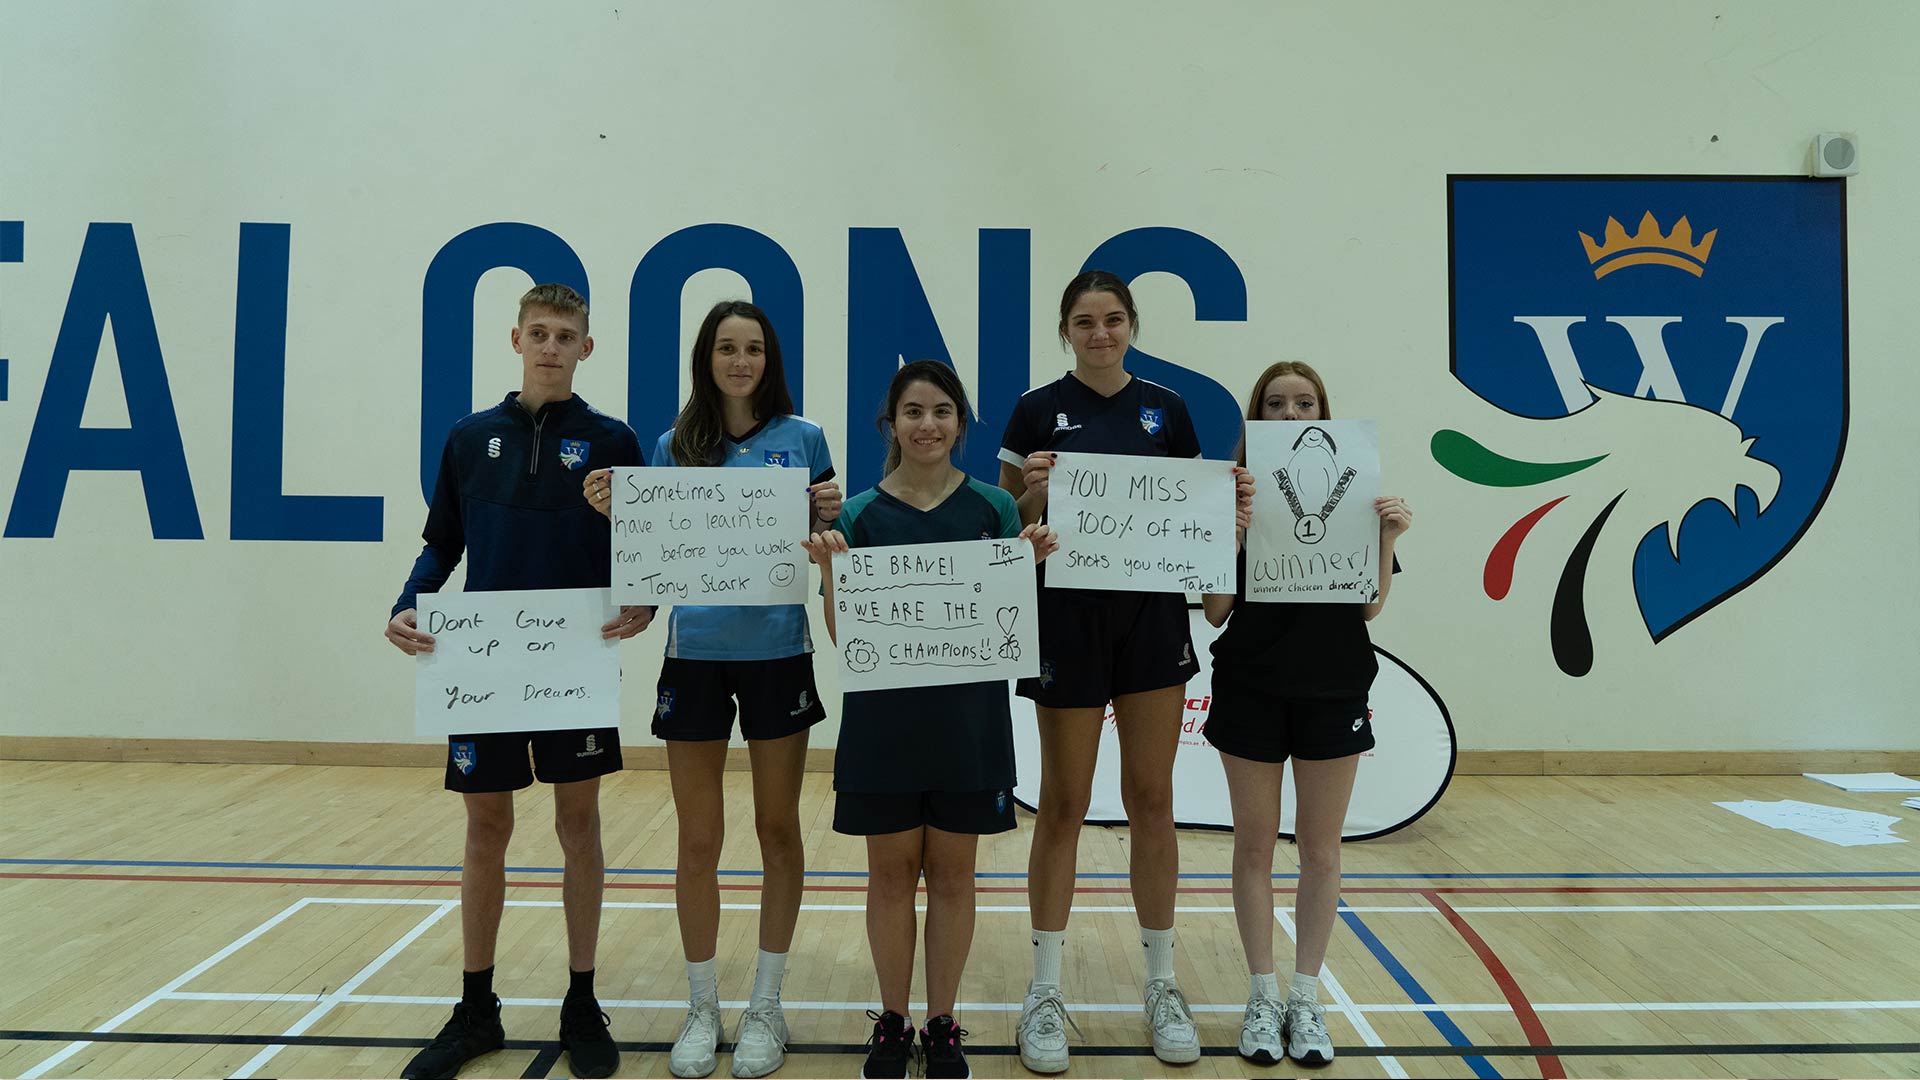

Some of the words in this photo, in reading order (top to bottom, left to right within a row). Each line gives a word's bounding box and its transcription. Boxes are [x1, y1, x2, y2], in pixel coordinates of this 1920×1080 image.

[0, 222, 1247, 541] ALCONS
[625, 474, 725, 504] Sometimes
[738, 485, 776, 512] you
[1067, 469, 1107, 497] YOU
[1129, 475, 1188, 502] MISS
[614, 514, 653, 537] have
[668, 512, 692, 530] to
[1077, 510, 1133, 539] 100%
[1181, 520, 1212, 542] the
[1302, 520, 1316, 538] 1
[616, 549, 642, 564] run
[661, 543, 706, 563] before
[716, 545, 748, 568] you
[851, 554, 874, 577] BE
[890, 555, 955, 581] BRAVE!
[1124, 558, 1151, 577] you
[1157, 557, 1195, 573] dont
[641, 572, 689, 598] Tony
[701, 573, 750, 593] Stark
[429, 610, 484, 635] Dont
[516, 610, 567, 629] Give
[854, 601, 880, 617] WE
[891, 601, 924, 621] ARE
[943, 601, 978, 621] THE
[468, 640, 499, 656] up
[527, 641, 555, 651] on
